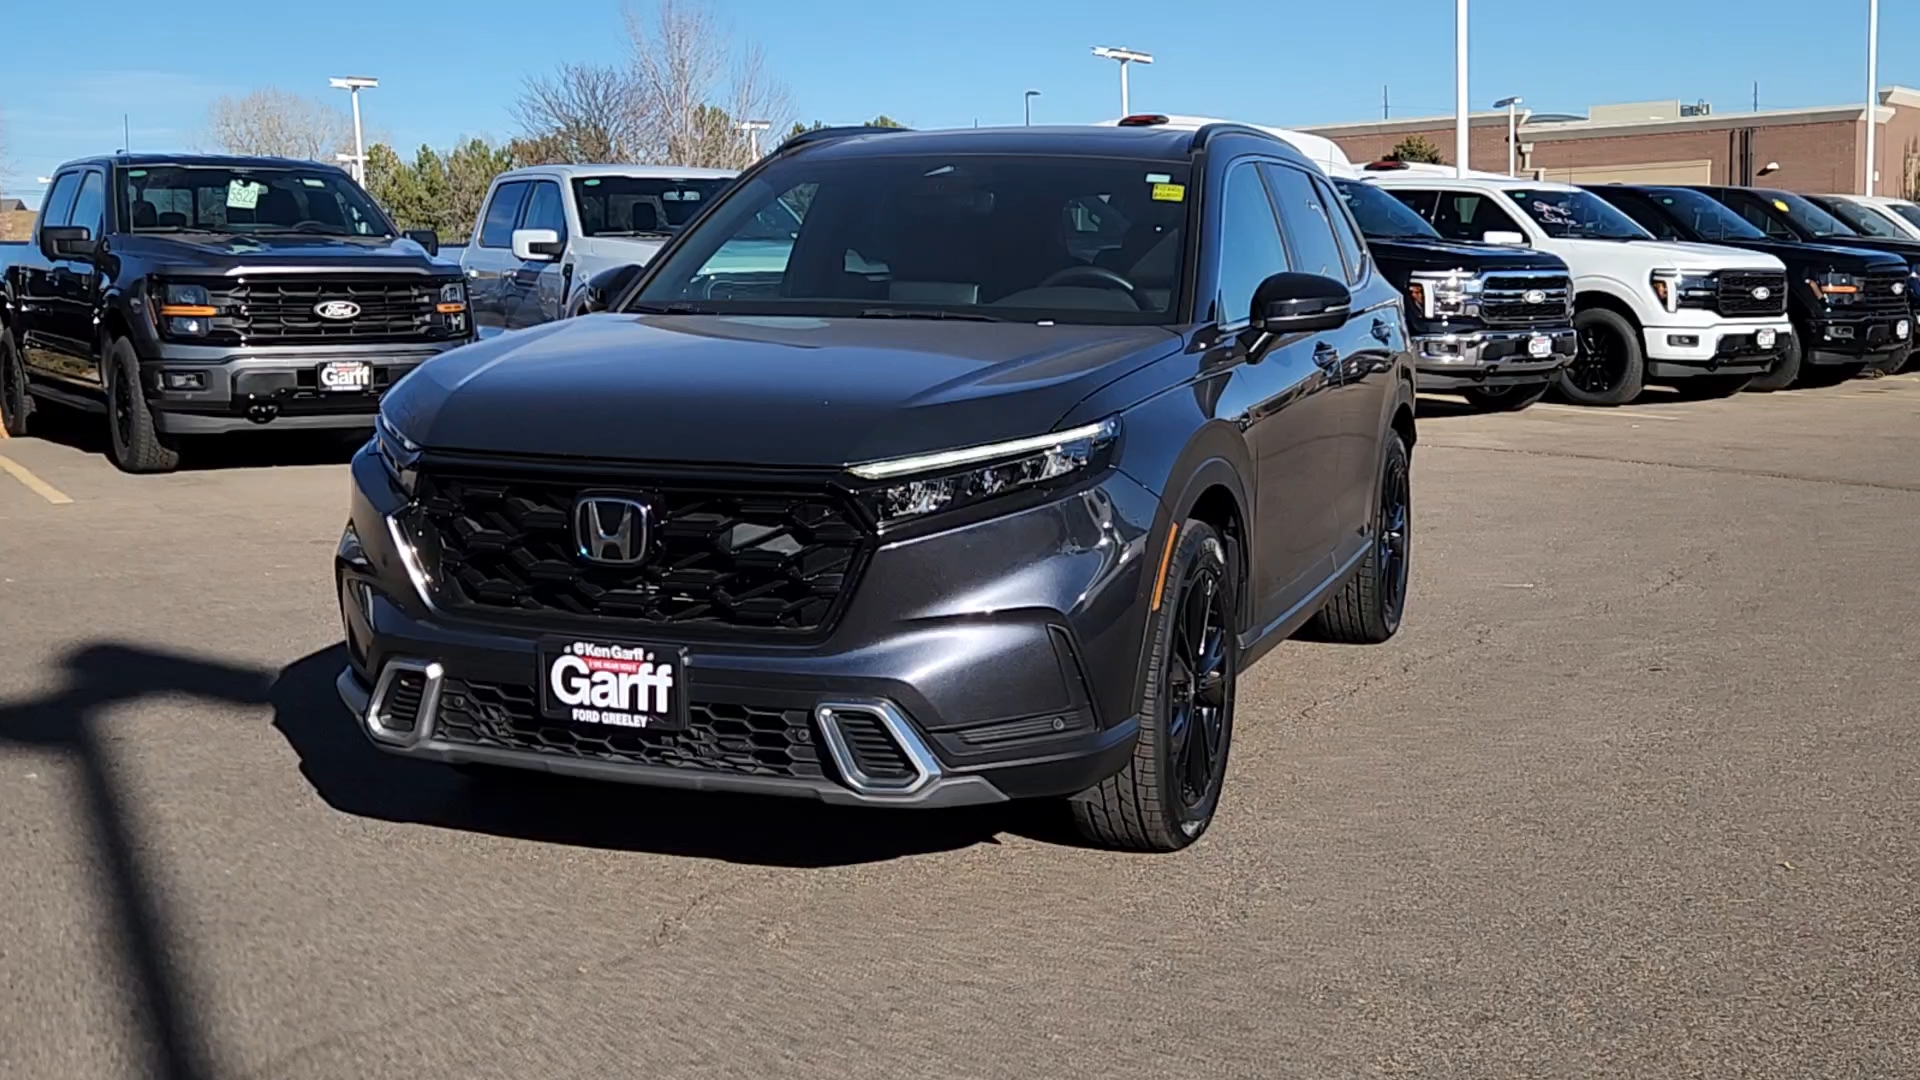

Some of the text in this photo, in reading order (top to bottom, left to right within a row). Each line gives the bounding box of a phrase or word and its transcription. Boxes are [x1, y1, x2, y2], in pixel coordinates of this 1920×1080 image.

[321, 366, 370, 386] Garff
[551, 655, 673, 713] Garff
[572, 708, 649, 728] FORD GREELEY
